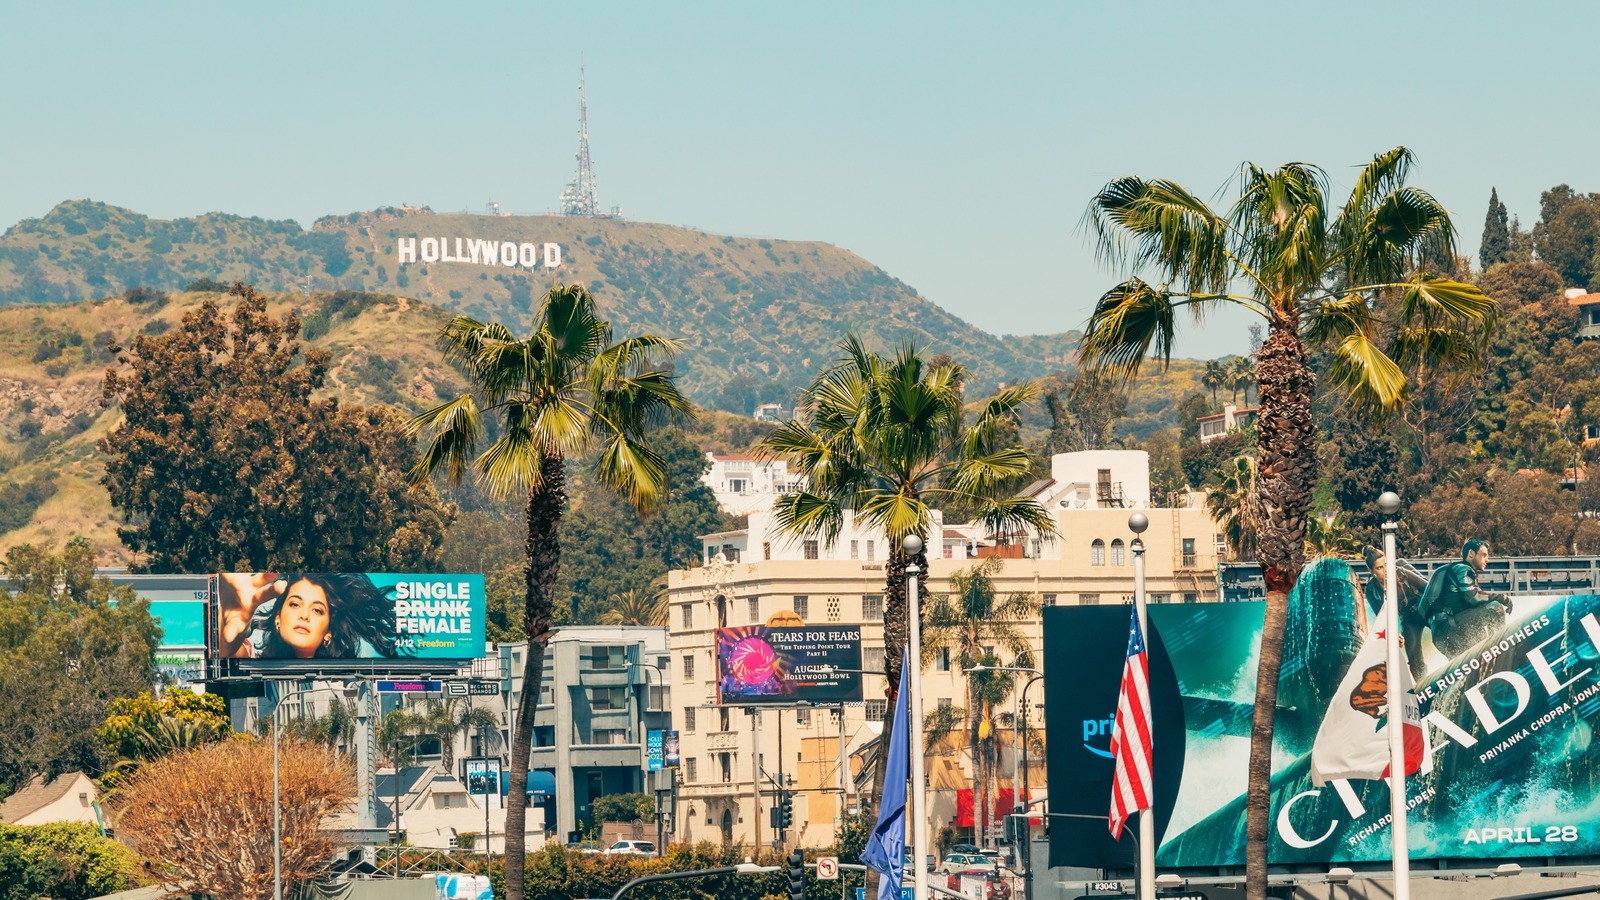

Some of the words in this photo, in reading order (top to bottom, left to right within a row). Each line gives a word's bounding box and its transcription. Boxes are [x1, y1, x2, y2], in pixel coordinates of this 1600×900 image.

[398, 237, 561, 268] HOLLYWOOD
[395, 582, 470, 599] SINGLE
[395, 600, 471, 617] DRUNK
[395, 618, 471, 633] FEMALE
[394, 639, 414, 647] 4/12
[417, 639, 455, 648] Freeform
[771, 632, 803, 642] TEARS
[806, 632, 826, 641] FOR
[829, 631, 860, 641] FEARS
[1415, 686, 1436, 704] HE
[1436, 659, 1480, 691] RUSSO
[1482, 614, 1550, 662] BROTHERS
[794, 664, 831, 673] AUGUS
[1479, 729, 1530, 764] PRIYANKA
[1530, 703, 1571, 731] CHOPRA
[1349, 814, 1392, 846] RICHARD
[1405, 787, 1436, 811] ADDEN
[1464, 827, 1541, 844] APRIL
[1545, 826, 1578, 842] 28
